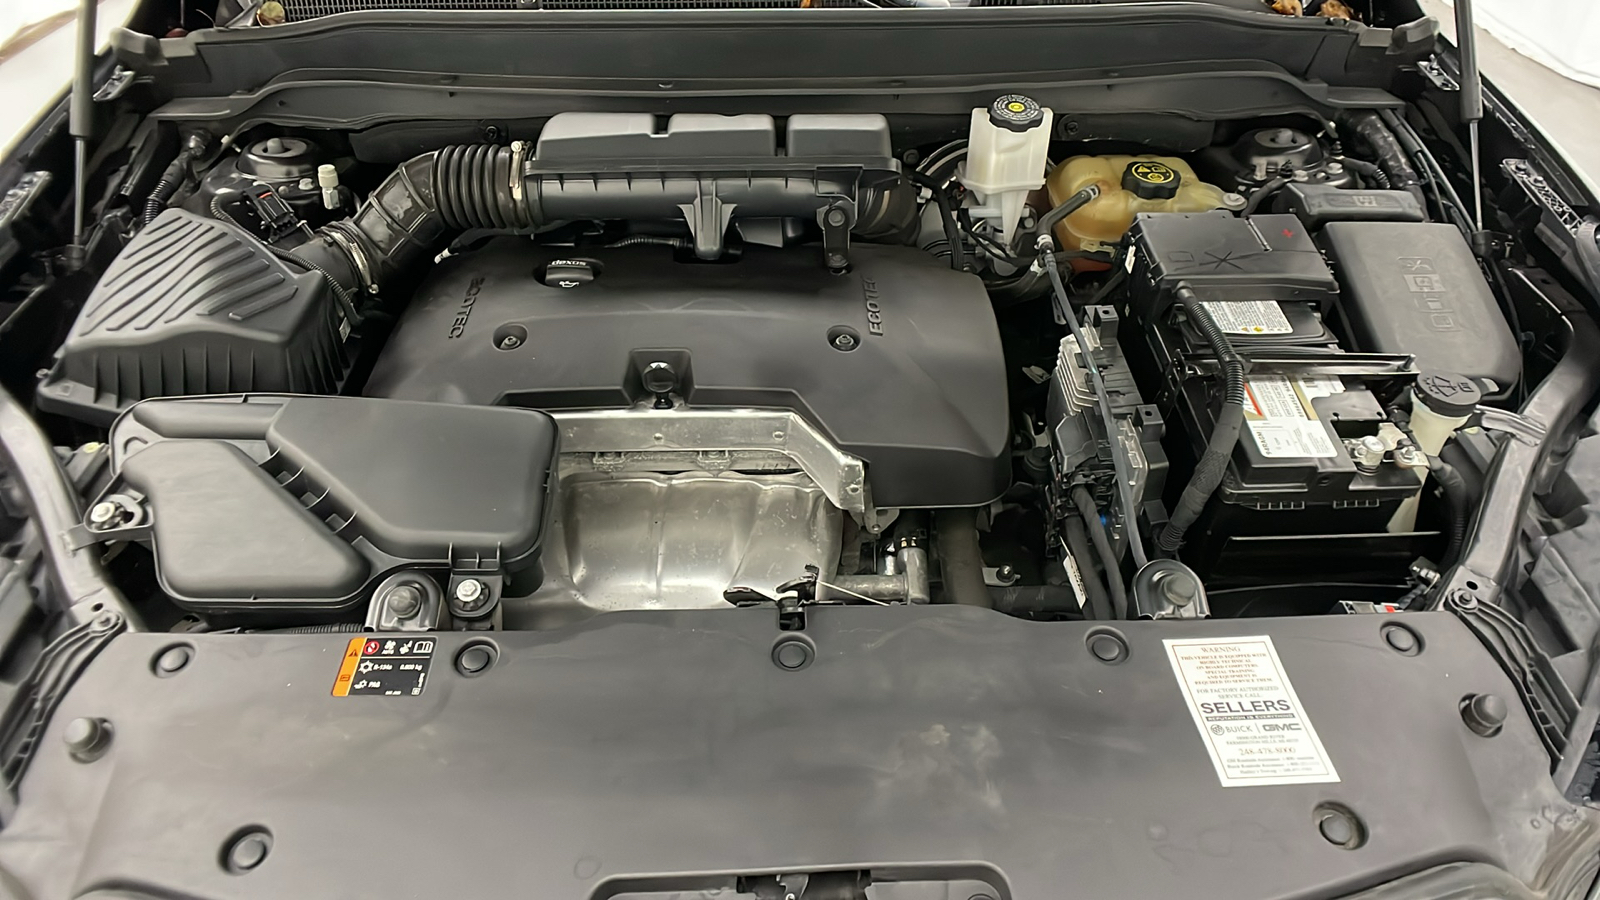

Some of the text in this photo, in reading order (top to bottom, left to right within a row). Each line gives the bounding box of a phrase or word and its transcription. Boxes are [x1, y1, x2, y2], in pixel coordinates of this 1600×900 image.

[1200, 699, 1291, 714] SELLERS
[1225, 723, 1302, 733] BUICK GMC
